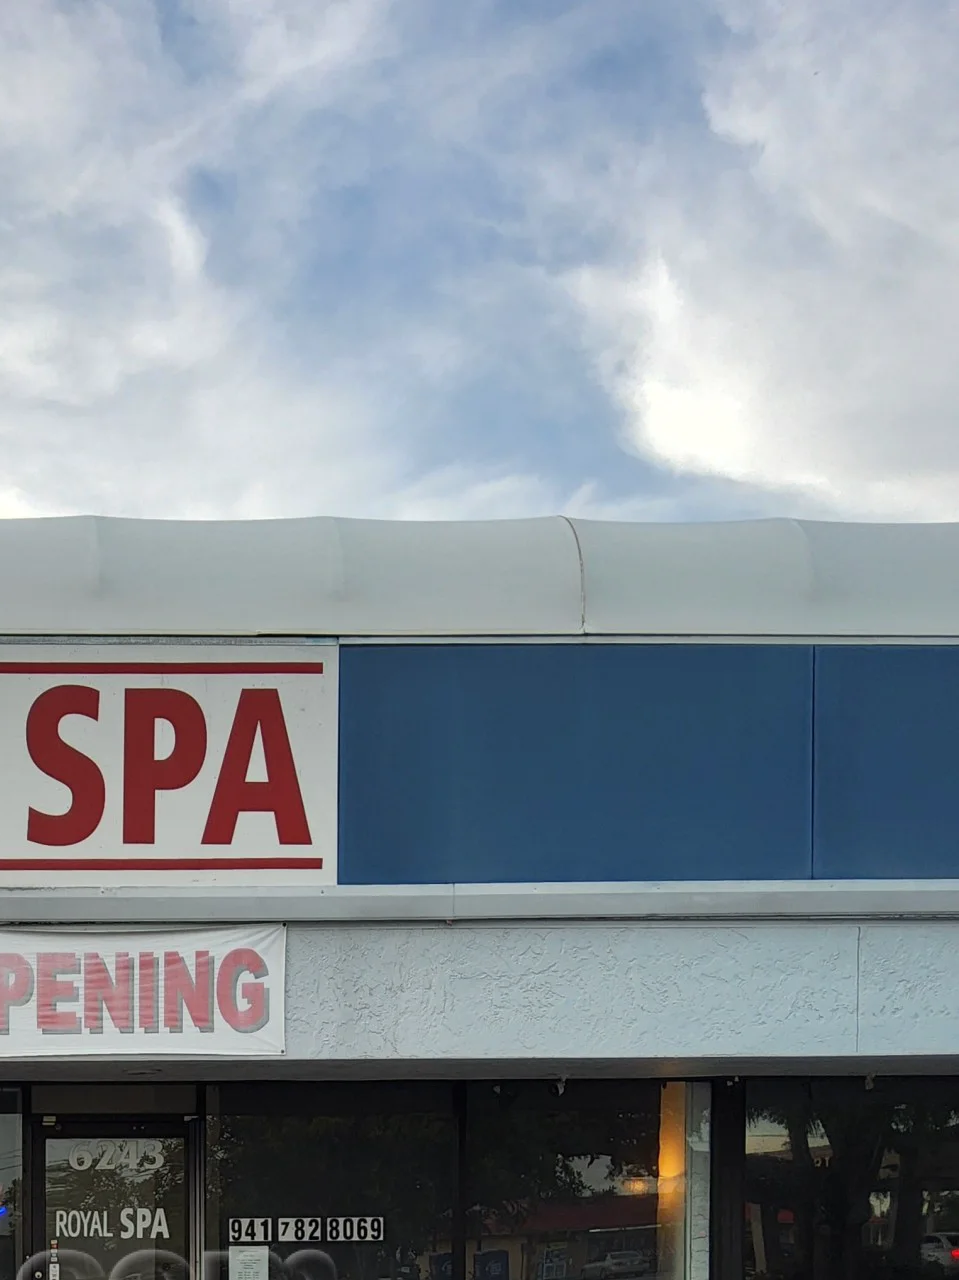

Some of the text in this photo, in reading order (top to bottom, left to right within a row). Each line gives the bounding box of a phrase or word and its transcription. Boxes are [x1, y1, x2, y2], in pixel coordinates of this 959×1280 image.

[25, 684, 313, 847] SPA
[68, 1140, 165, 1171] 6243
[55, 1207, 170, 1239] ROYAL SPA
[230, 1217, 382, 1241] 941 782 8069
